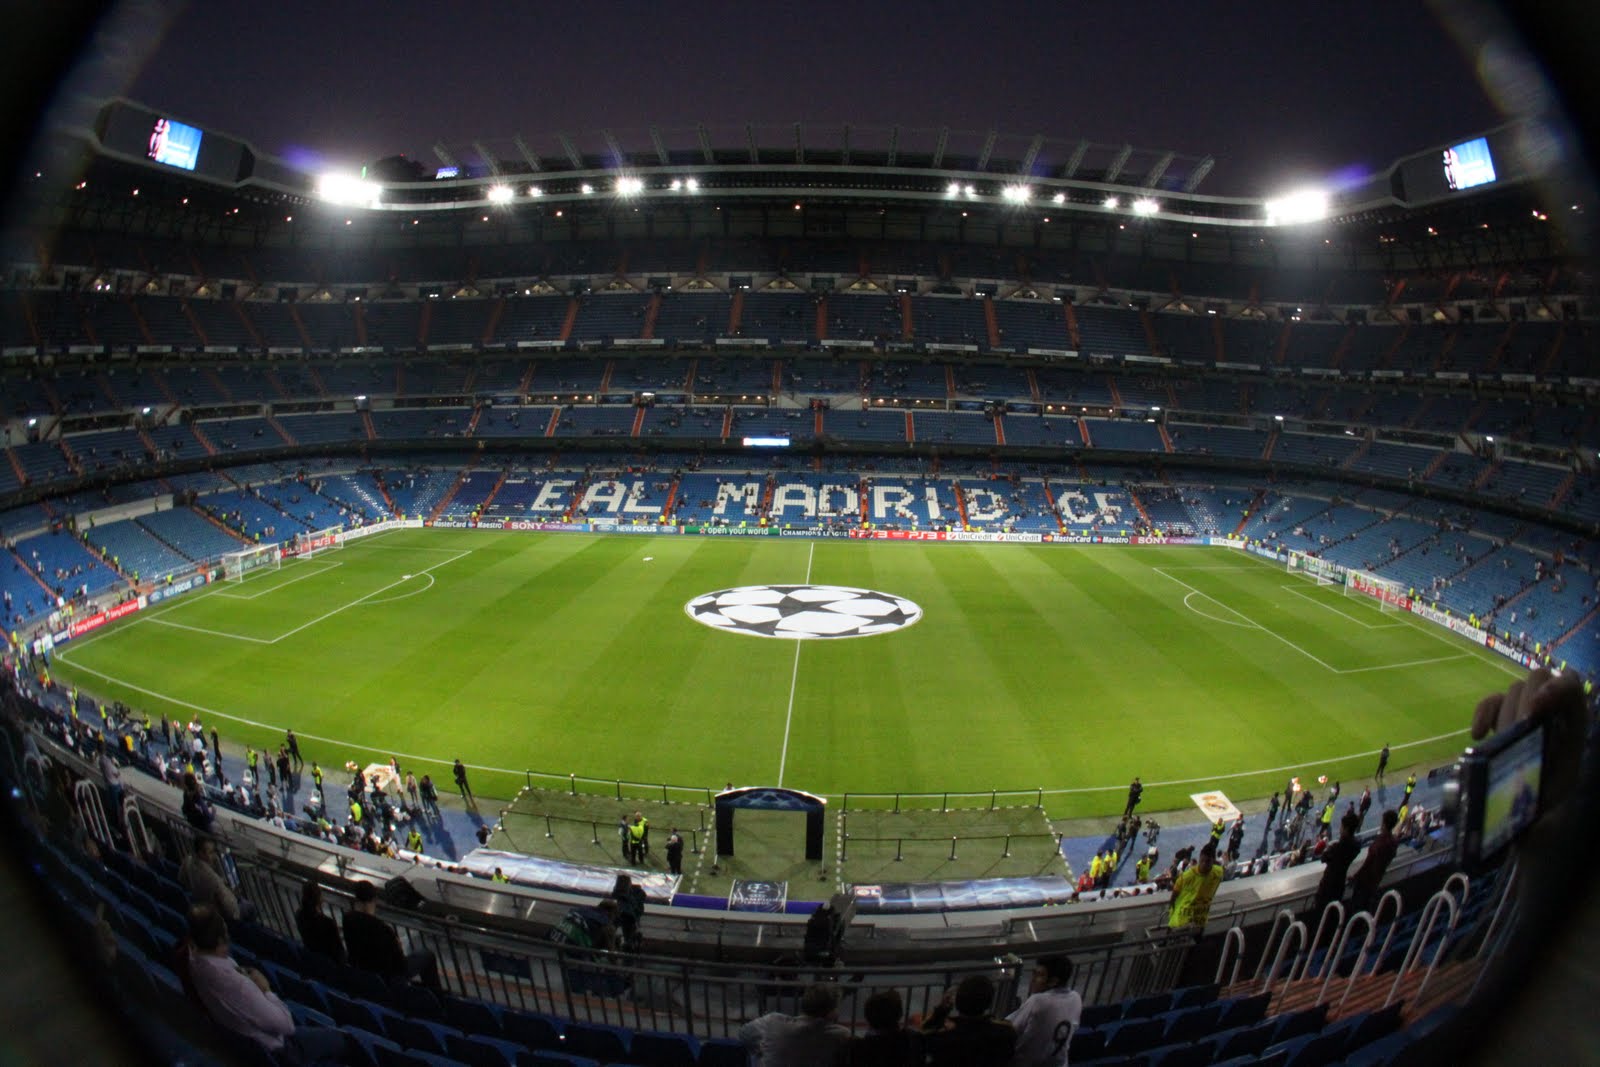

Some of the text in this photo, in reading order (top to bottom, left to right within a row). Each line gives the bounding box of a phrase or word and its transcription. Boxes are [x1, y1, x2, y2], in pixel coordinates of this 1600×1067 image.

[712, 481, 1003, 521] MADRID
[1056, 488, 1125, 526] CF
[433, 521, 503, 530] MasterCard Maestro
[511, 521, 543, 531] SONY
[616, 525, 632, 533] NEW
[632, 525, 657, 533] FOCUS
[707, 527, 769, 536] open your world
[782, 529, 821, 537] CHAMPIONS
[908, 530, 938, 540] PS3
[957, 533, 993, 541] UniCredit
[1005, 533, 1040, 542] UniCredit
[1053, 535, 1129, 544] MasterCard Maestro
[1137, 536, 1169, 545] SONY
[174, 580, 192, 593] FOCUS
[1052, 1019, 1071, 1057] 9
